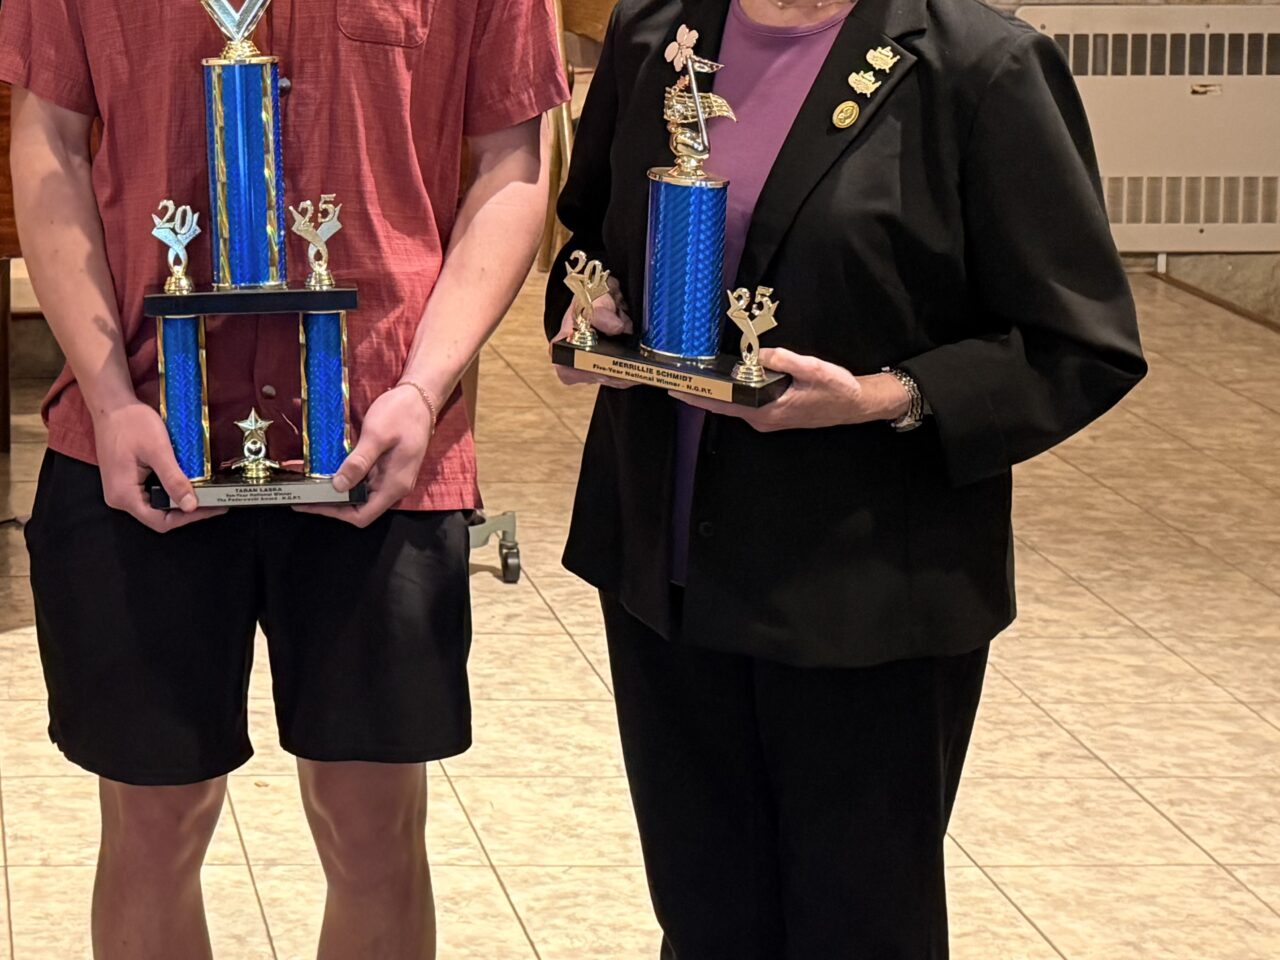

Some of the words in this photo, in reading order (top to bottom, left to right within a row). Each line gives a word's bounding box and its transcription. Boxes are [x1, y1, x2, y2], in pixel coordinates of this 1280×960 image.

[157, 199, 193, 234] 20
[297, 193, 336, 230] 25
[568, 249, 602, 288] 20
[731, 285, 774, 319] 25
[592, 363, 624, 375] Five-Year
[625, 370, 655, 382] National
[656, 377, 681, 388] Winner
[612, 359, 654, 374] MERRILLIE
[656, 369, 693, 383] SCHMIDT
